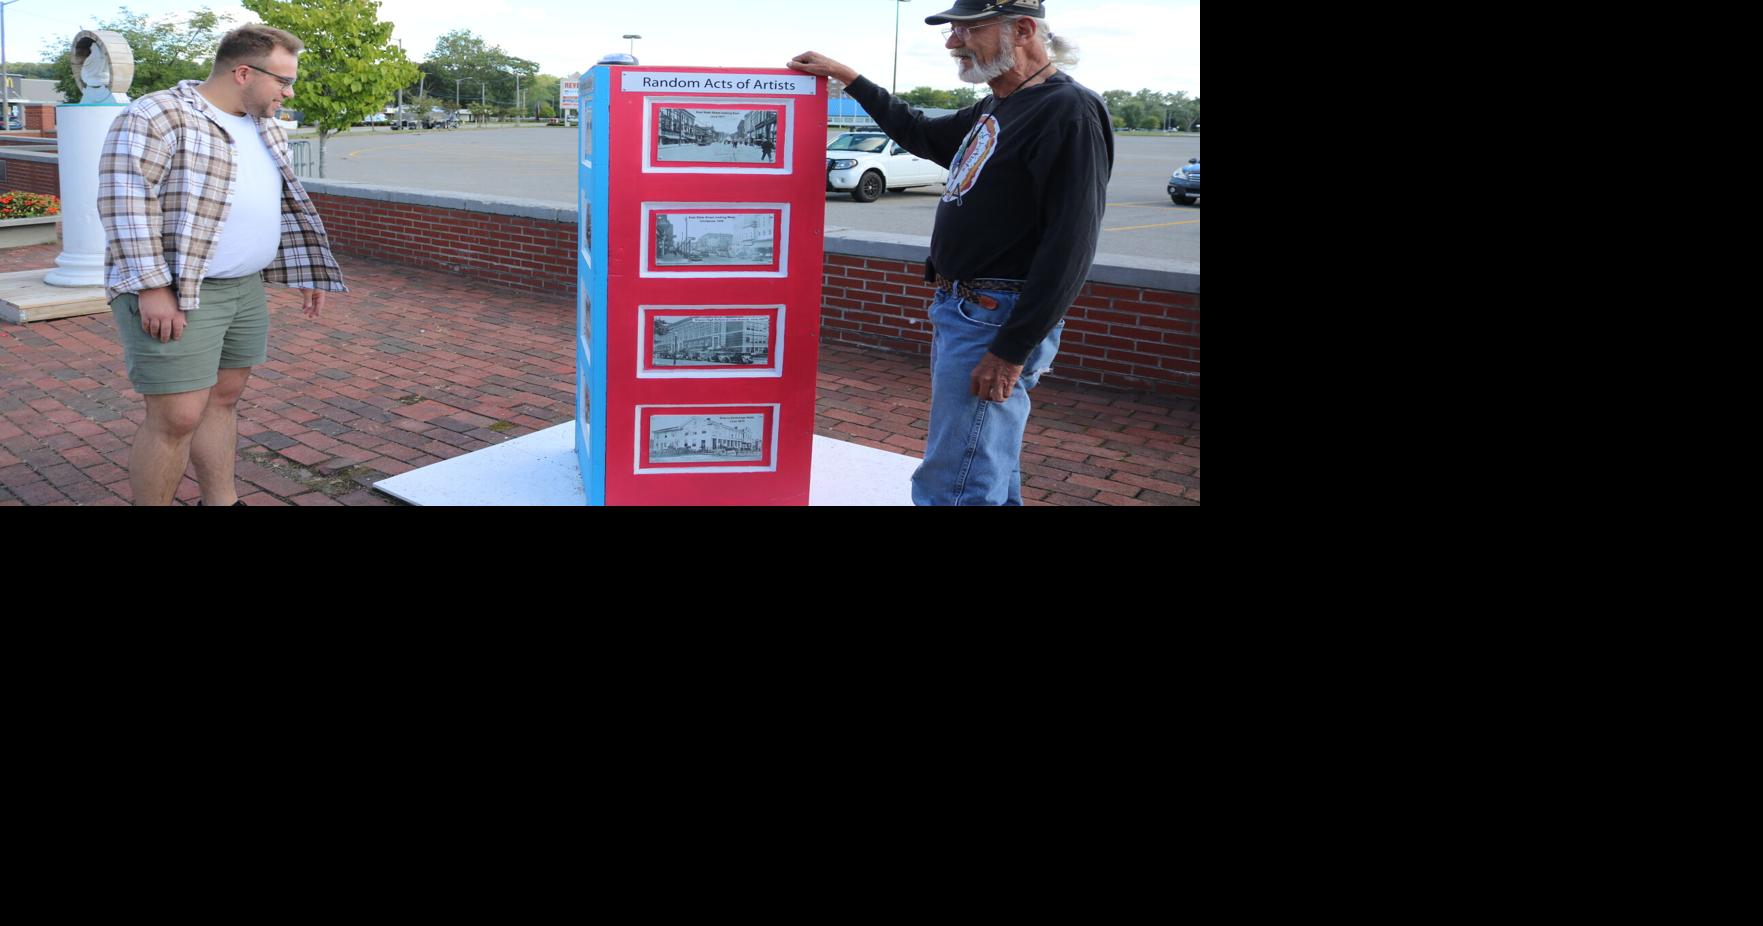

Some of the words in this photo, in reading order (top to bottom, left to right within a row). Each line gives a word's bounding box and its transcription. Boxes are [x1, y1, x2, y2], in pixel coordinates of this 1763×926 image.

[643, 77, 700, 88] Random
[704, 78, 733, 89] Acts
[736, 79, 751, 89] of
[753, 79, 796, 91] Artists
